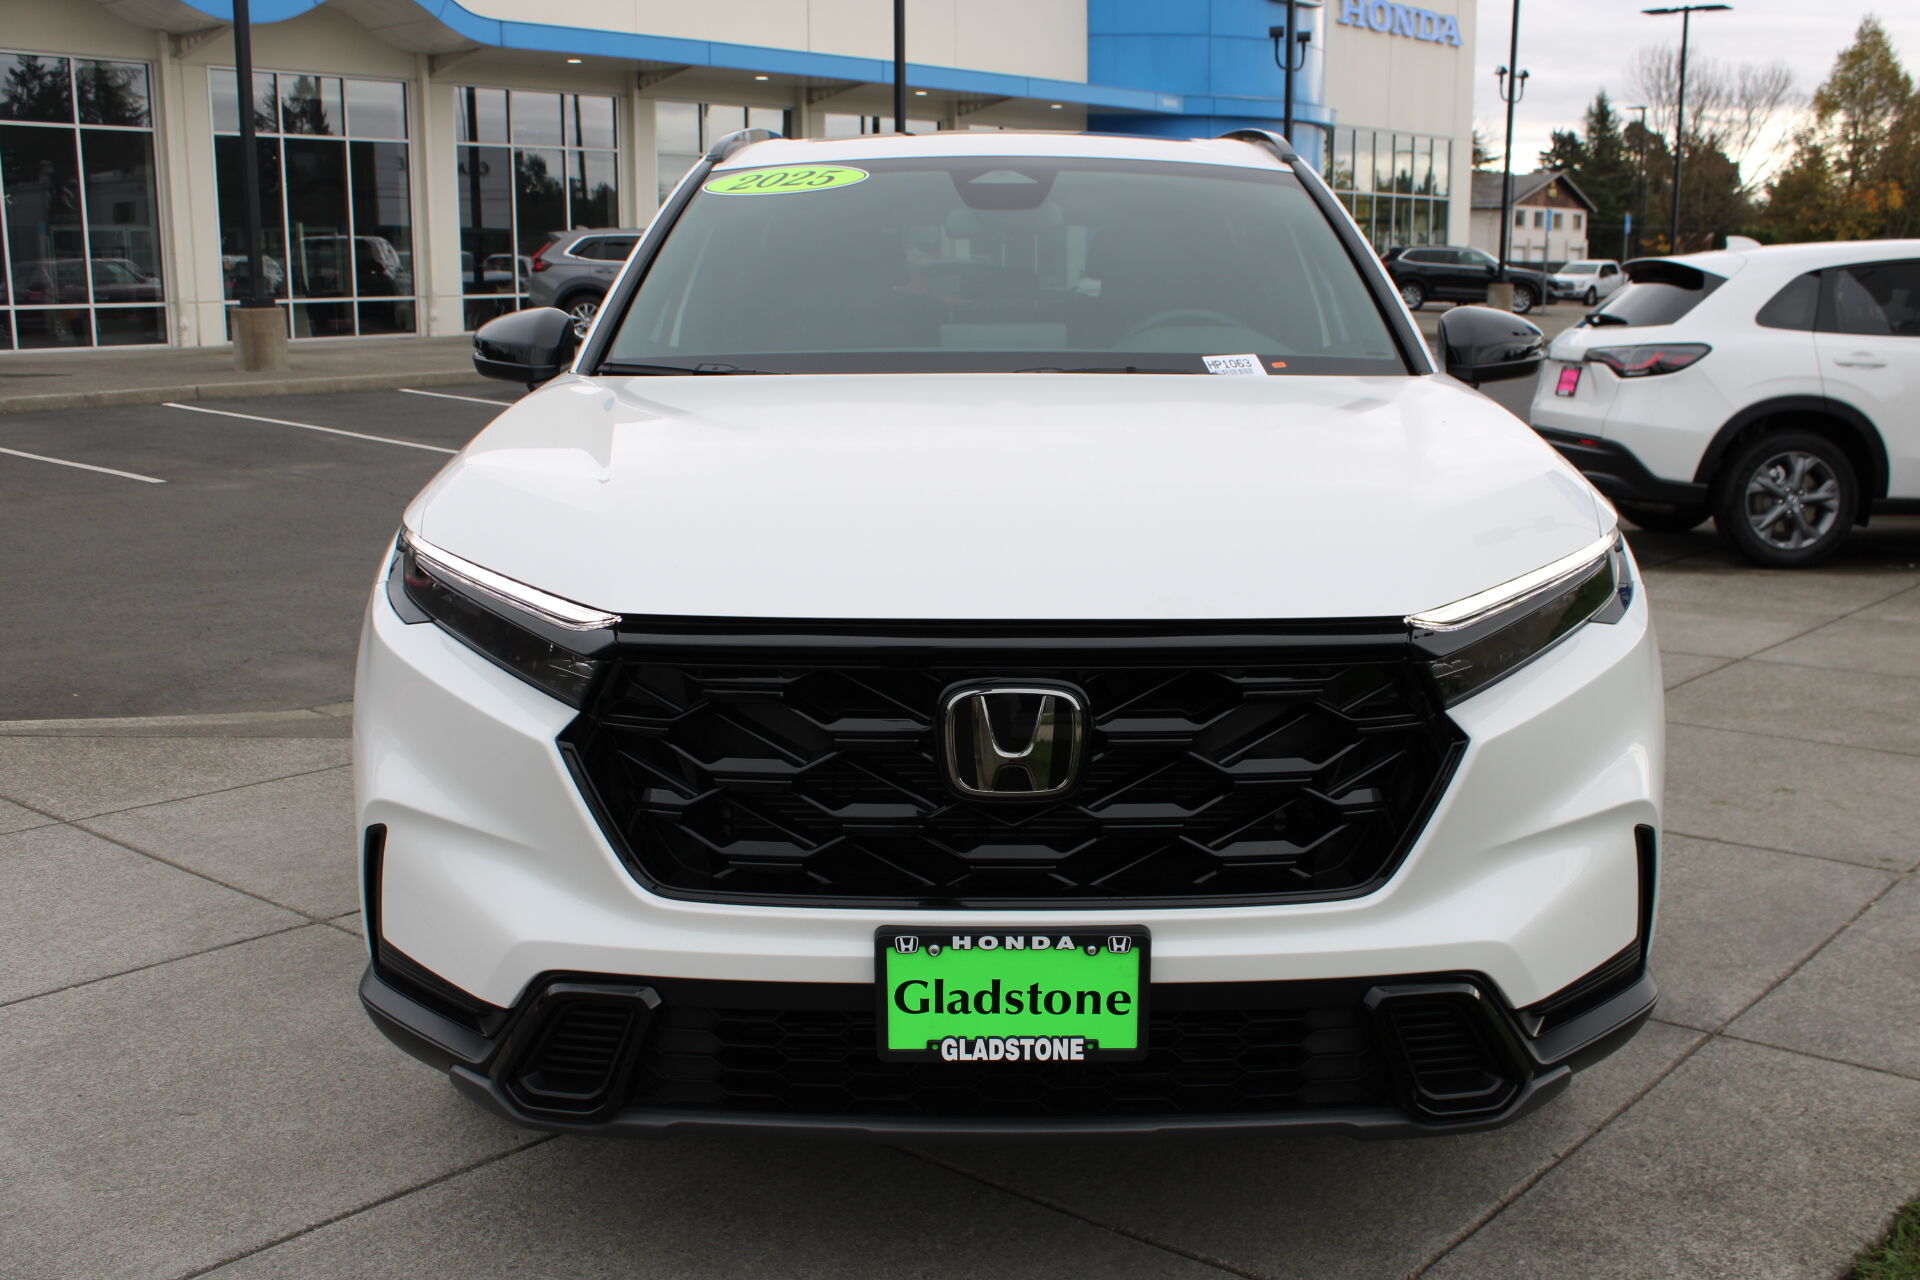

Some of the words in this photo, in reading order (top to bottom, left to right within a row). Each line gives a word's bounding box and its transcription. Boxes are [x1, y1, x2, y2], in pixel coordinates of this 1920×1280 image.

[1336, 0, 1463, 47] HONDA
[727, 171, 844, 190] 2025
[1207, 359, 1252, 370] HP1063
[952, 935, 1076, 950] HONDA
[894, 978, 1132, 1016] Gladstone
[941, 1037, 1084, 1061] GLADSTONE
